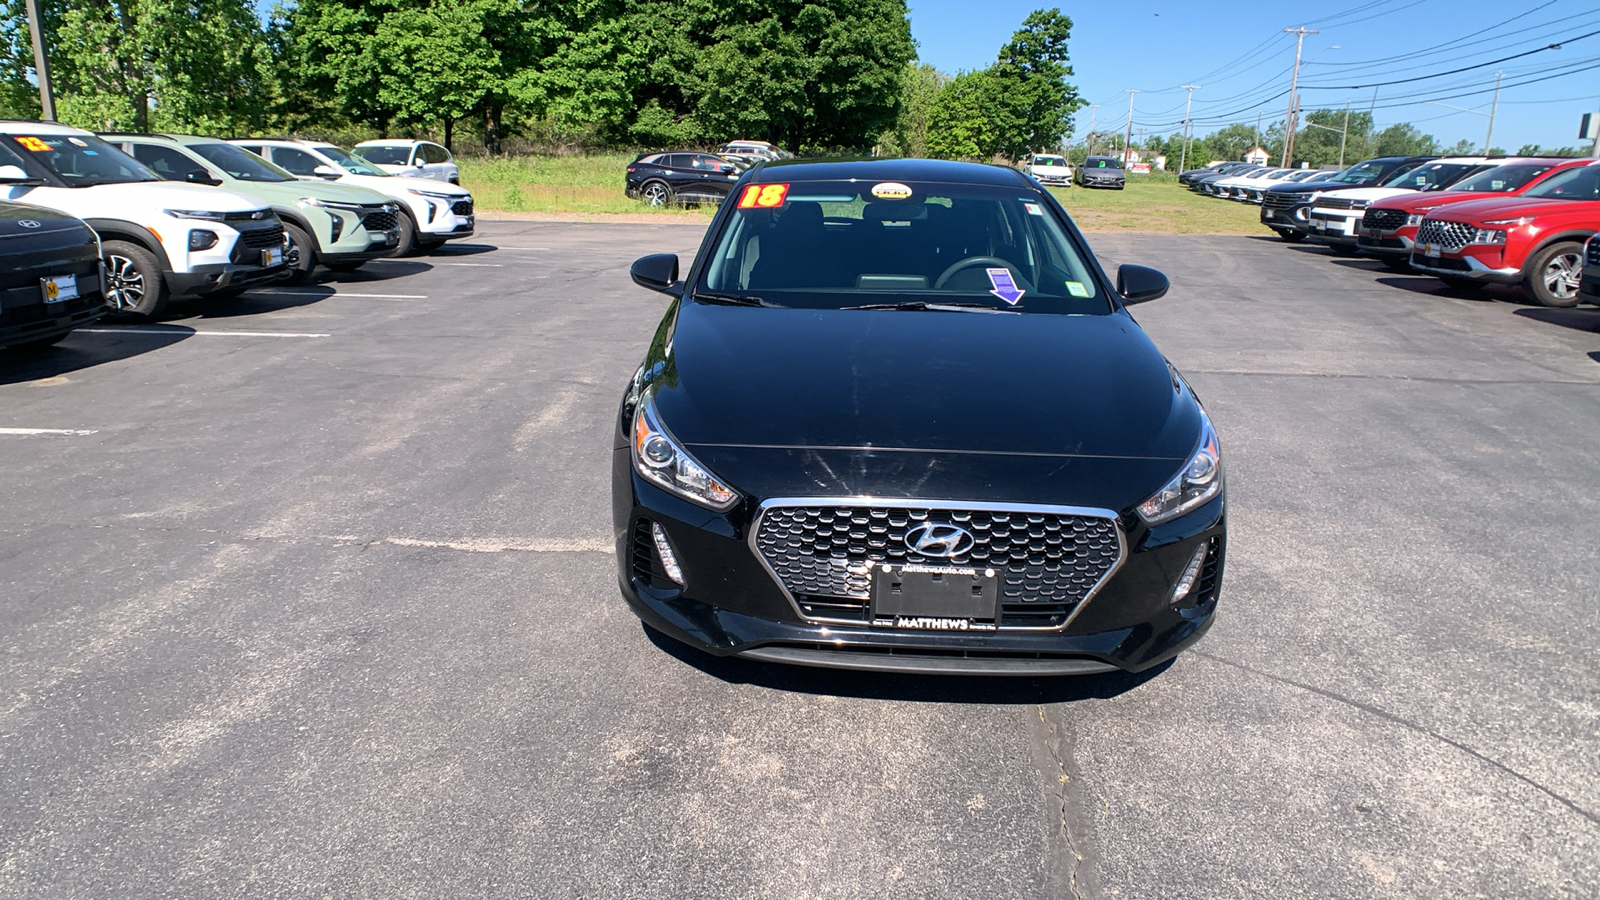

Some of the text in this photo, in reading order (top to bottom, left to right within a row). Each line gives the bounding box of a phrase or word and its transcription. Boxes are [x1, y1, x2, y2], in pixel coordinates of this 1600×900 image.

[18, 137, 50, 151] 23
[742, 186, 785, 206] 18
[898, 617, 968, 630] MATTHEWS
